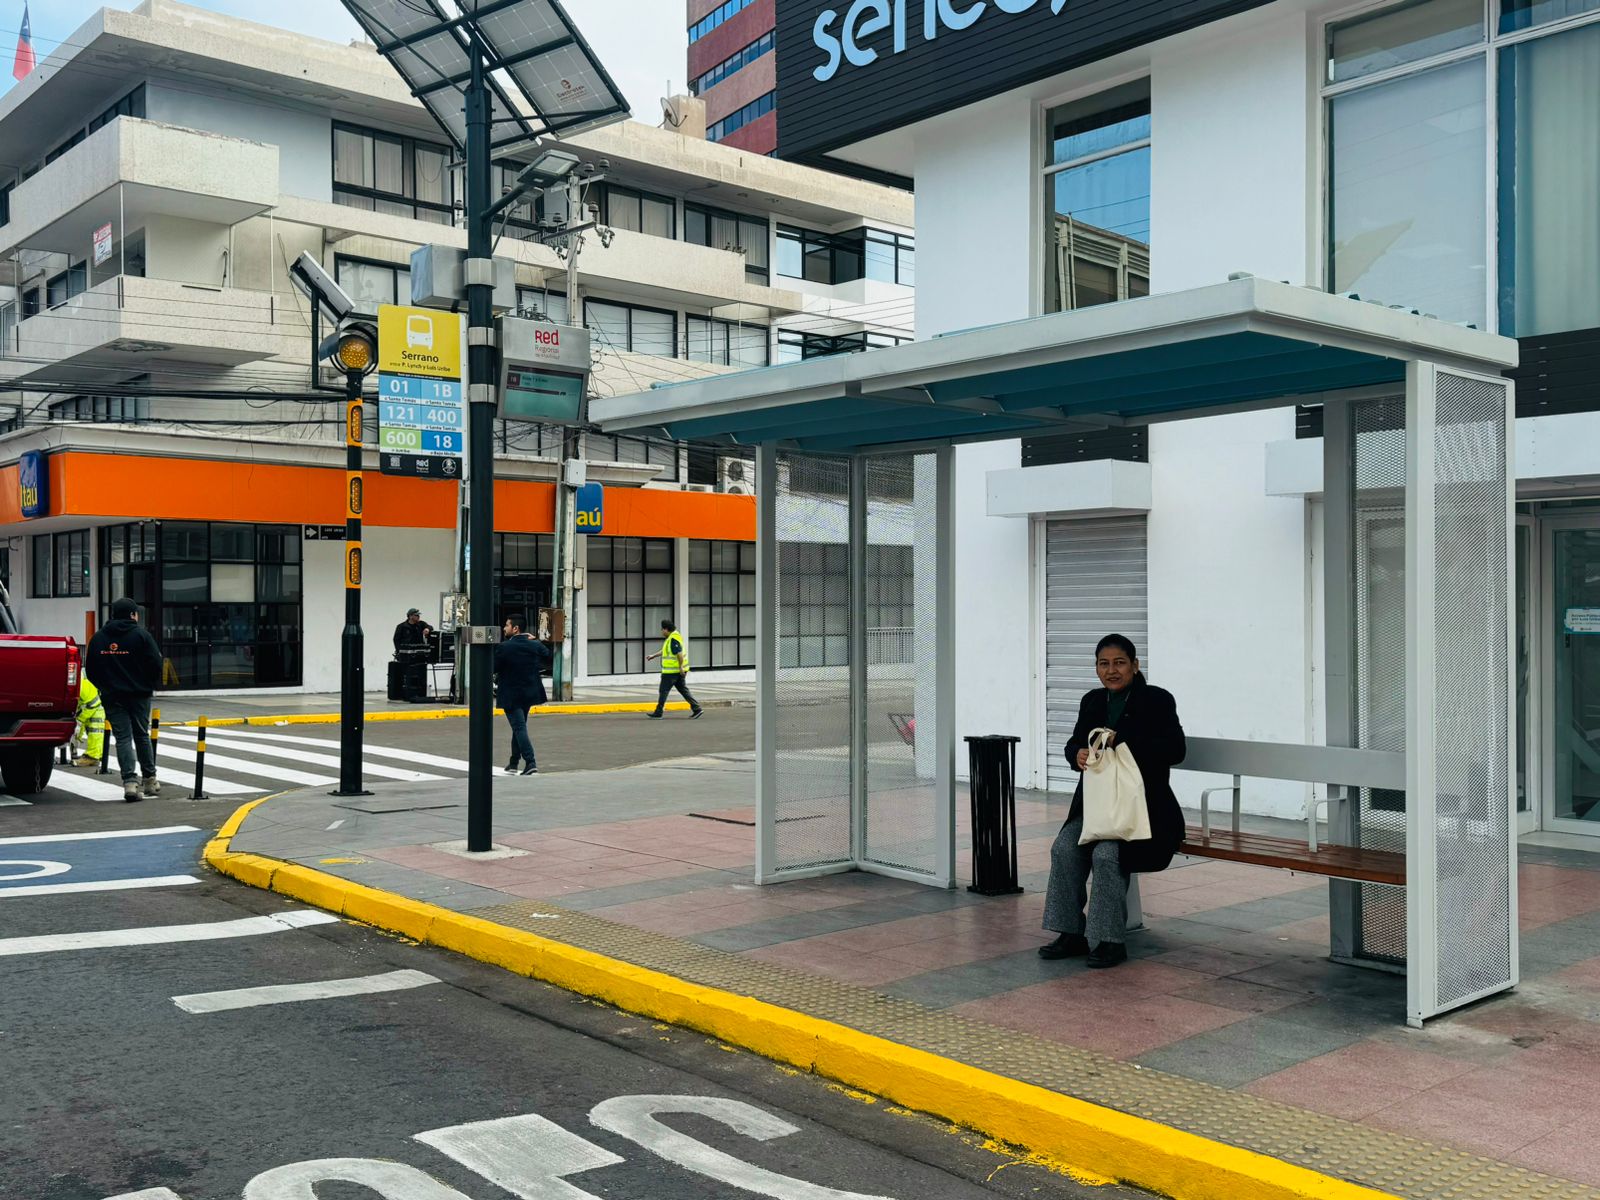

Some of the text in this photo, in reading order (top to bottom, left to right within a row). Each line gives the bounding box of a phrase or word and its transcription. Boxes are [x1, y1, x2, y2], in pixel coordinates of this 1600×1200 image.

[534, 329, 560, 346] Red
[401, 350, 440, 363] Serrano
[390, 379, 409, 394] 01
[433, 383, 452, 398] 1B
[387, 405, 414, 420] 121
[427, 409, 456, 424] 400
[386, 431, 417, 446] 600
[433, 434, 453, 449] 18
[576, 507, 601, 527] aú
